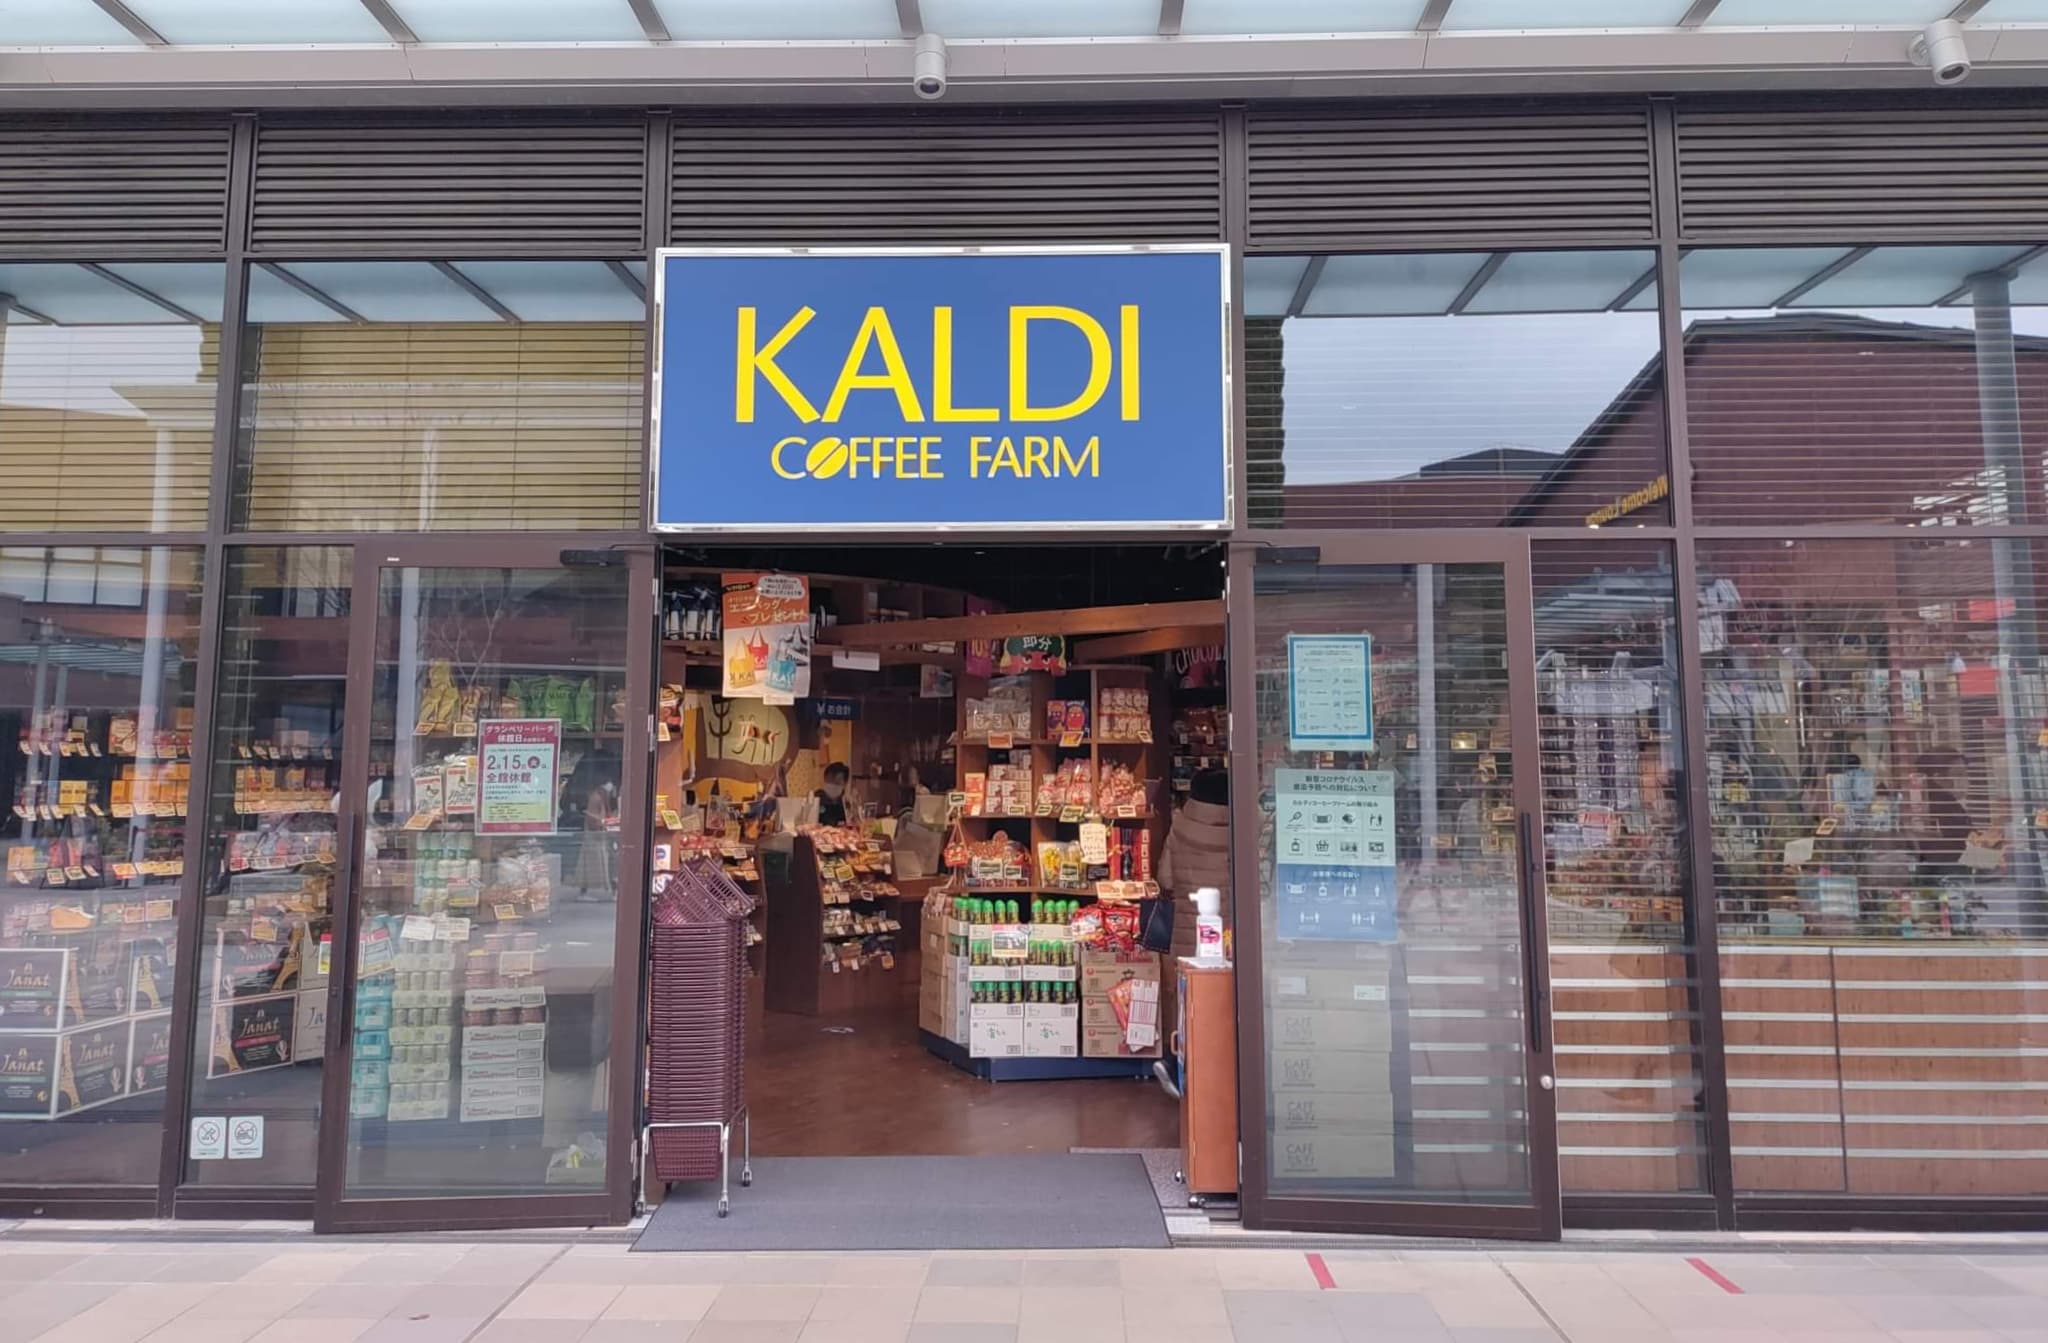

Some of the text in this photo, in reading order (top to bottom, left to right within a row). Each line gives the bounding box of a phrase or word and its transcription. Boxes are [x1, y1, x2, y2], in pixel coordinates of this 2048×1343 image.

[735, 304, 1141, 423] KALDI
[771, 436, 1100, 480] COFFEE FARM
[3, 969, 50, 988] Janat
[240, 1017, 280, 1036] Janat
